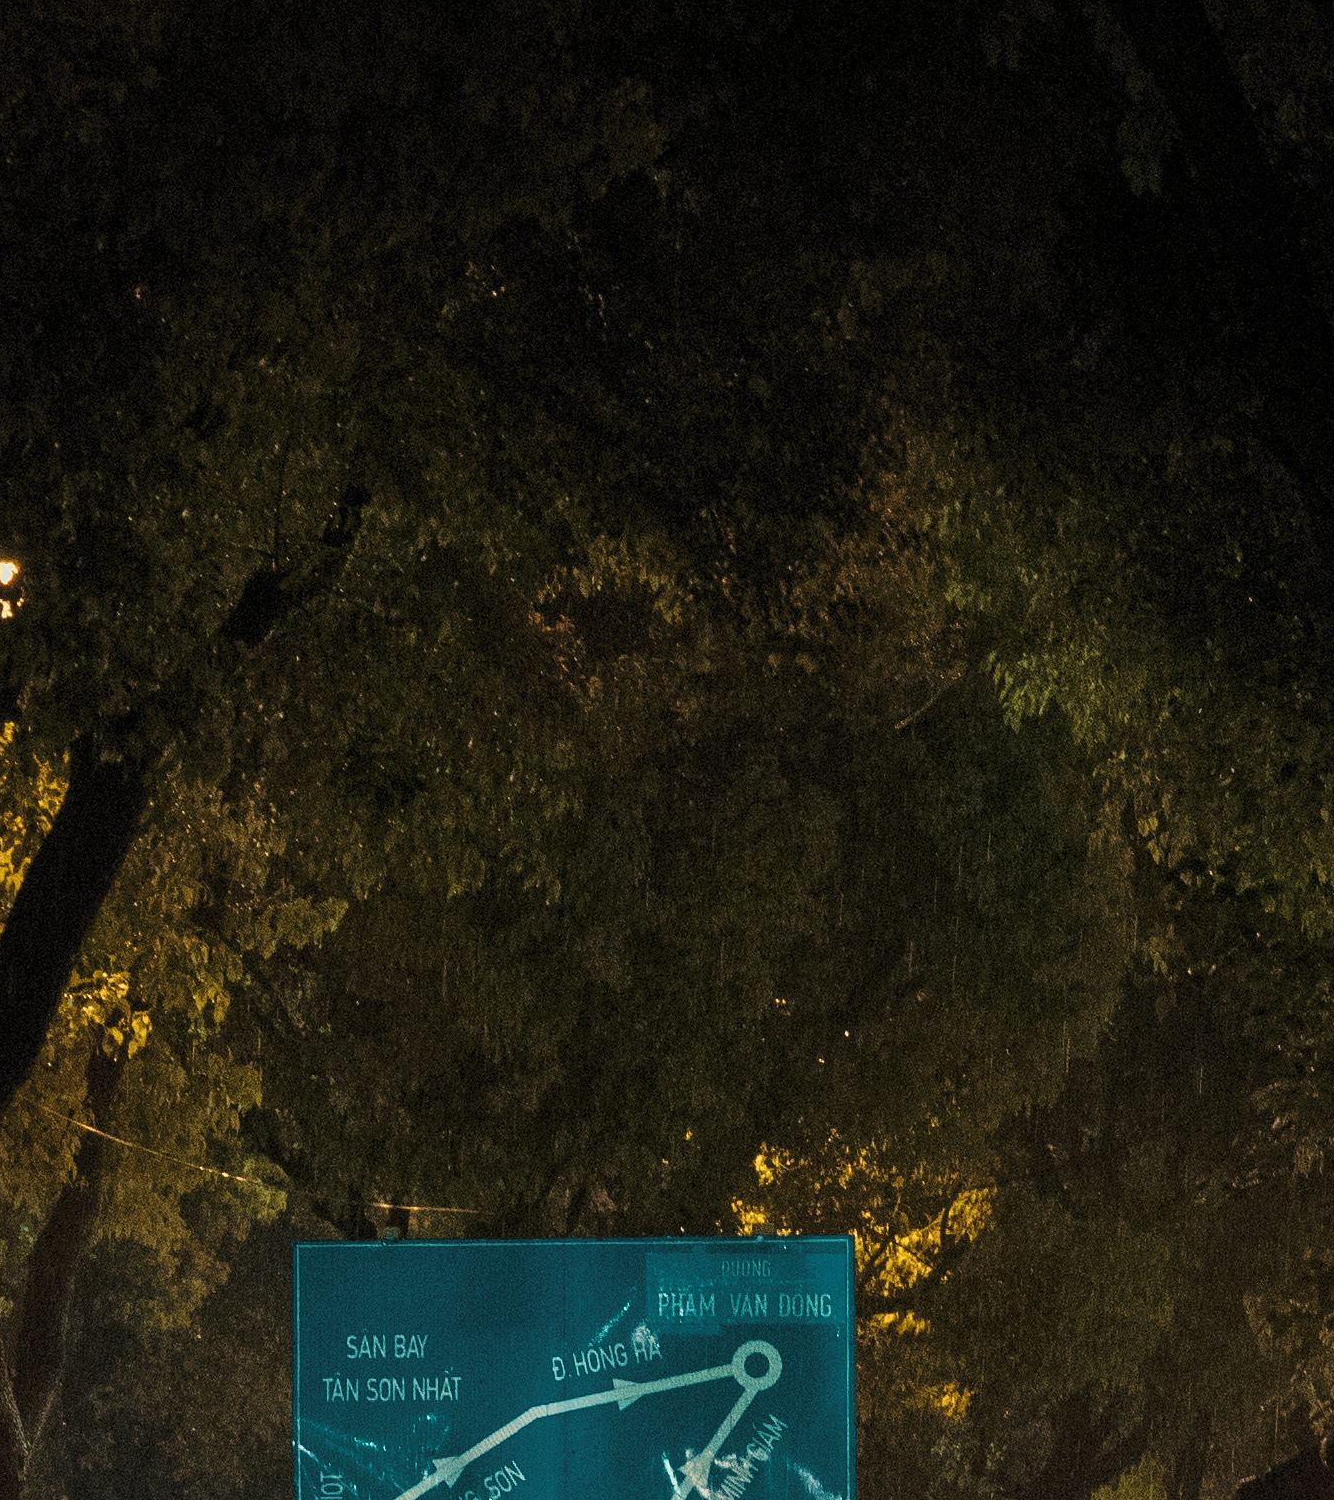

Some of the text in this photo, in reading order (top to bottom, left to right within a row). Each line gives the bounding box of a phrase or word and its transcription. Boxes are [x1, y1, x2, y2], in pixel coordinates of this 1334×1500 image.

[346, 1328, 428, 1359] SÂN BAY
[322, 1372, 359, 1401] TÂN
